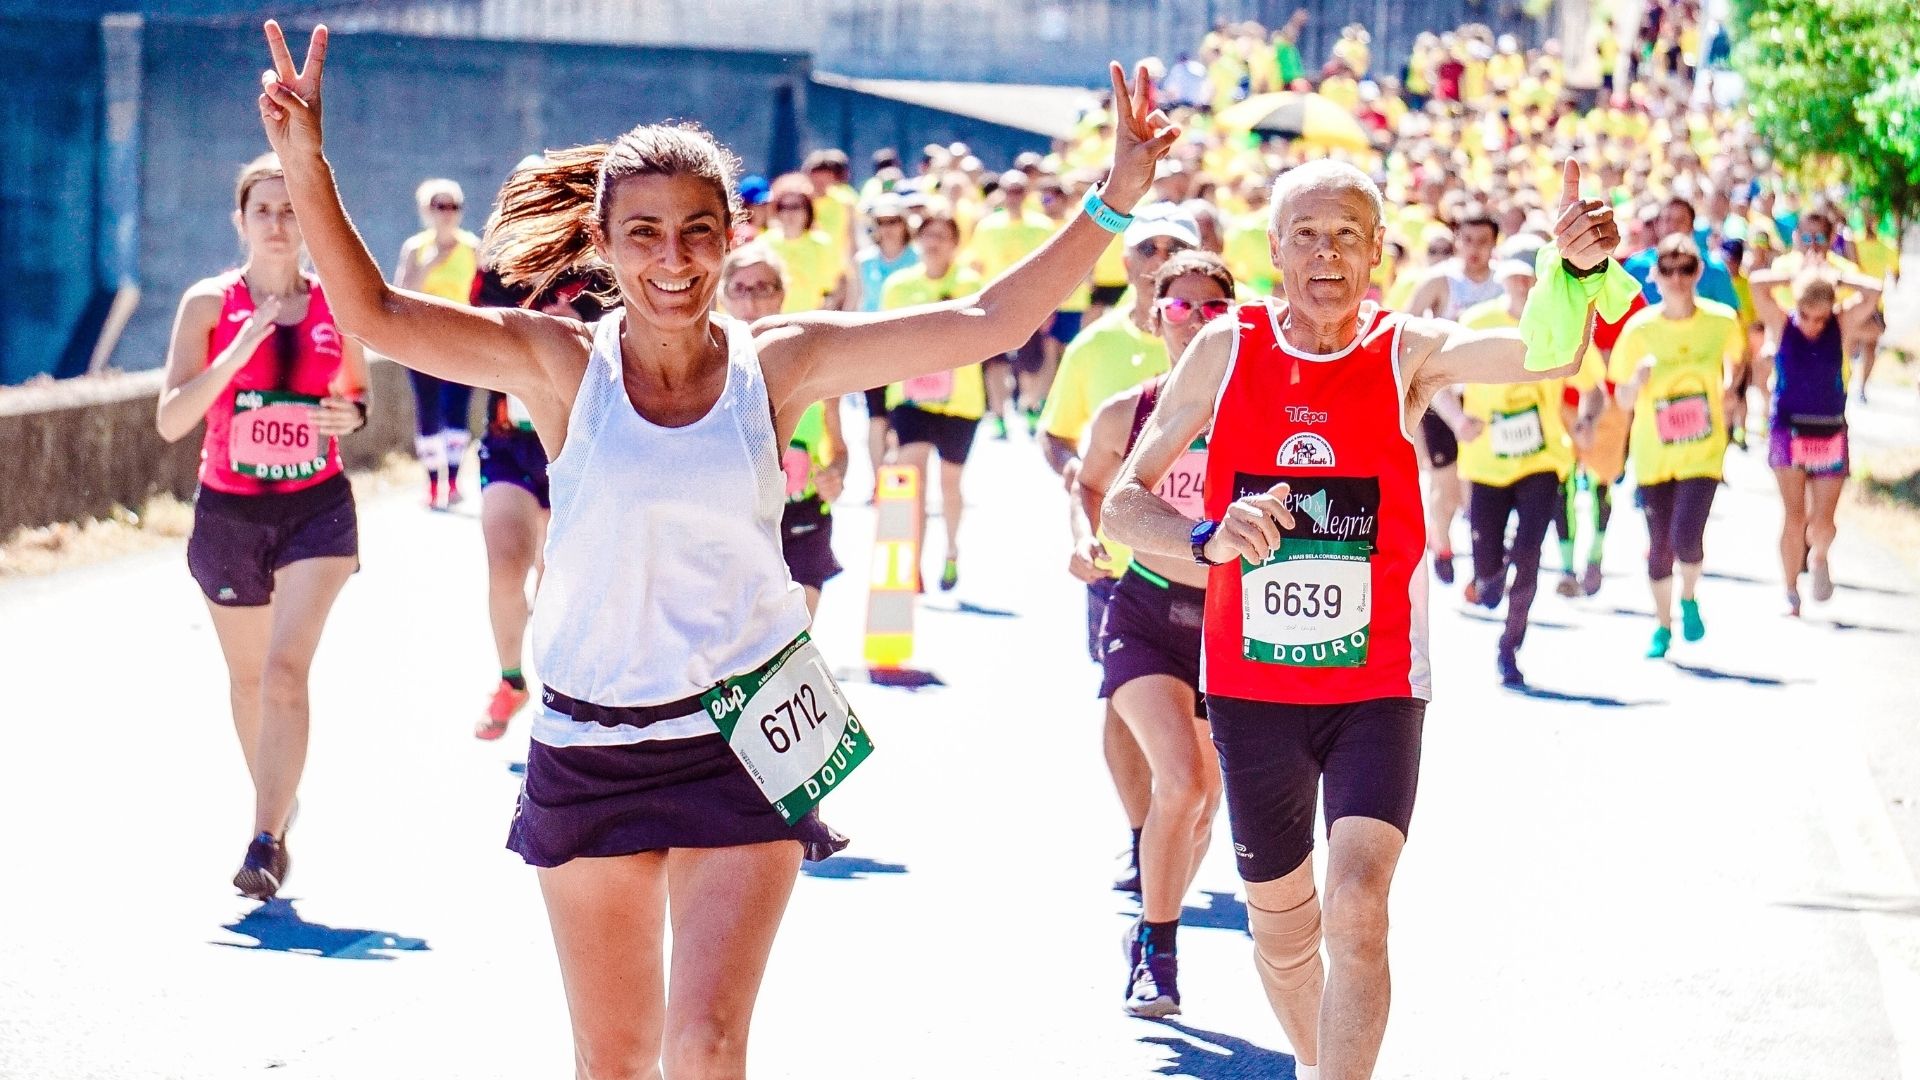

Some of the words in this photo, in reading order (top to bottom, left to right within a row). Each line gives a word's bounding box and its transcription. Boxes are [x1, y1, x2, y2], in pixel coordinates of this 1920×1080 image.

[252, 420, 309, 447] 6056
[256, 457, 326, 479] DOURO
[1312, 499, 1374, 541] alegria
[1264, 581, 1342, 618] 6639
[1273, 631, 1366, 662] DOURO
[760, 683, 827, 754] 6712
[804, 714, 860, 800] DOURO
